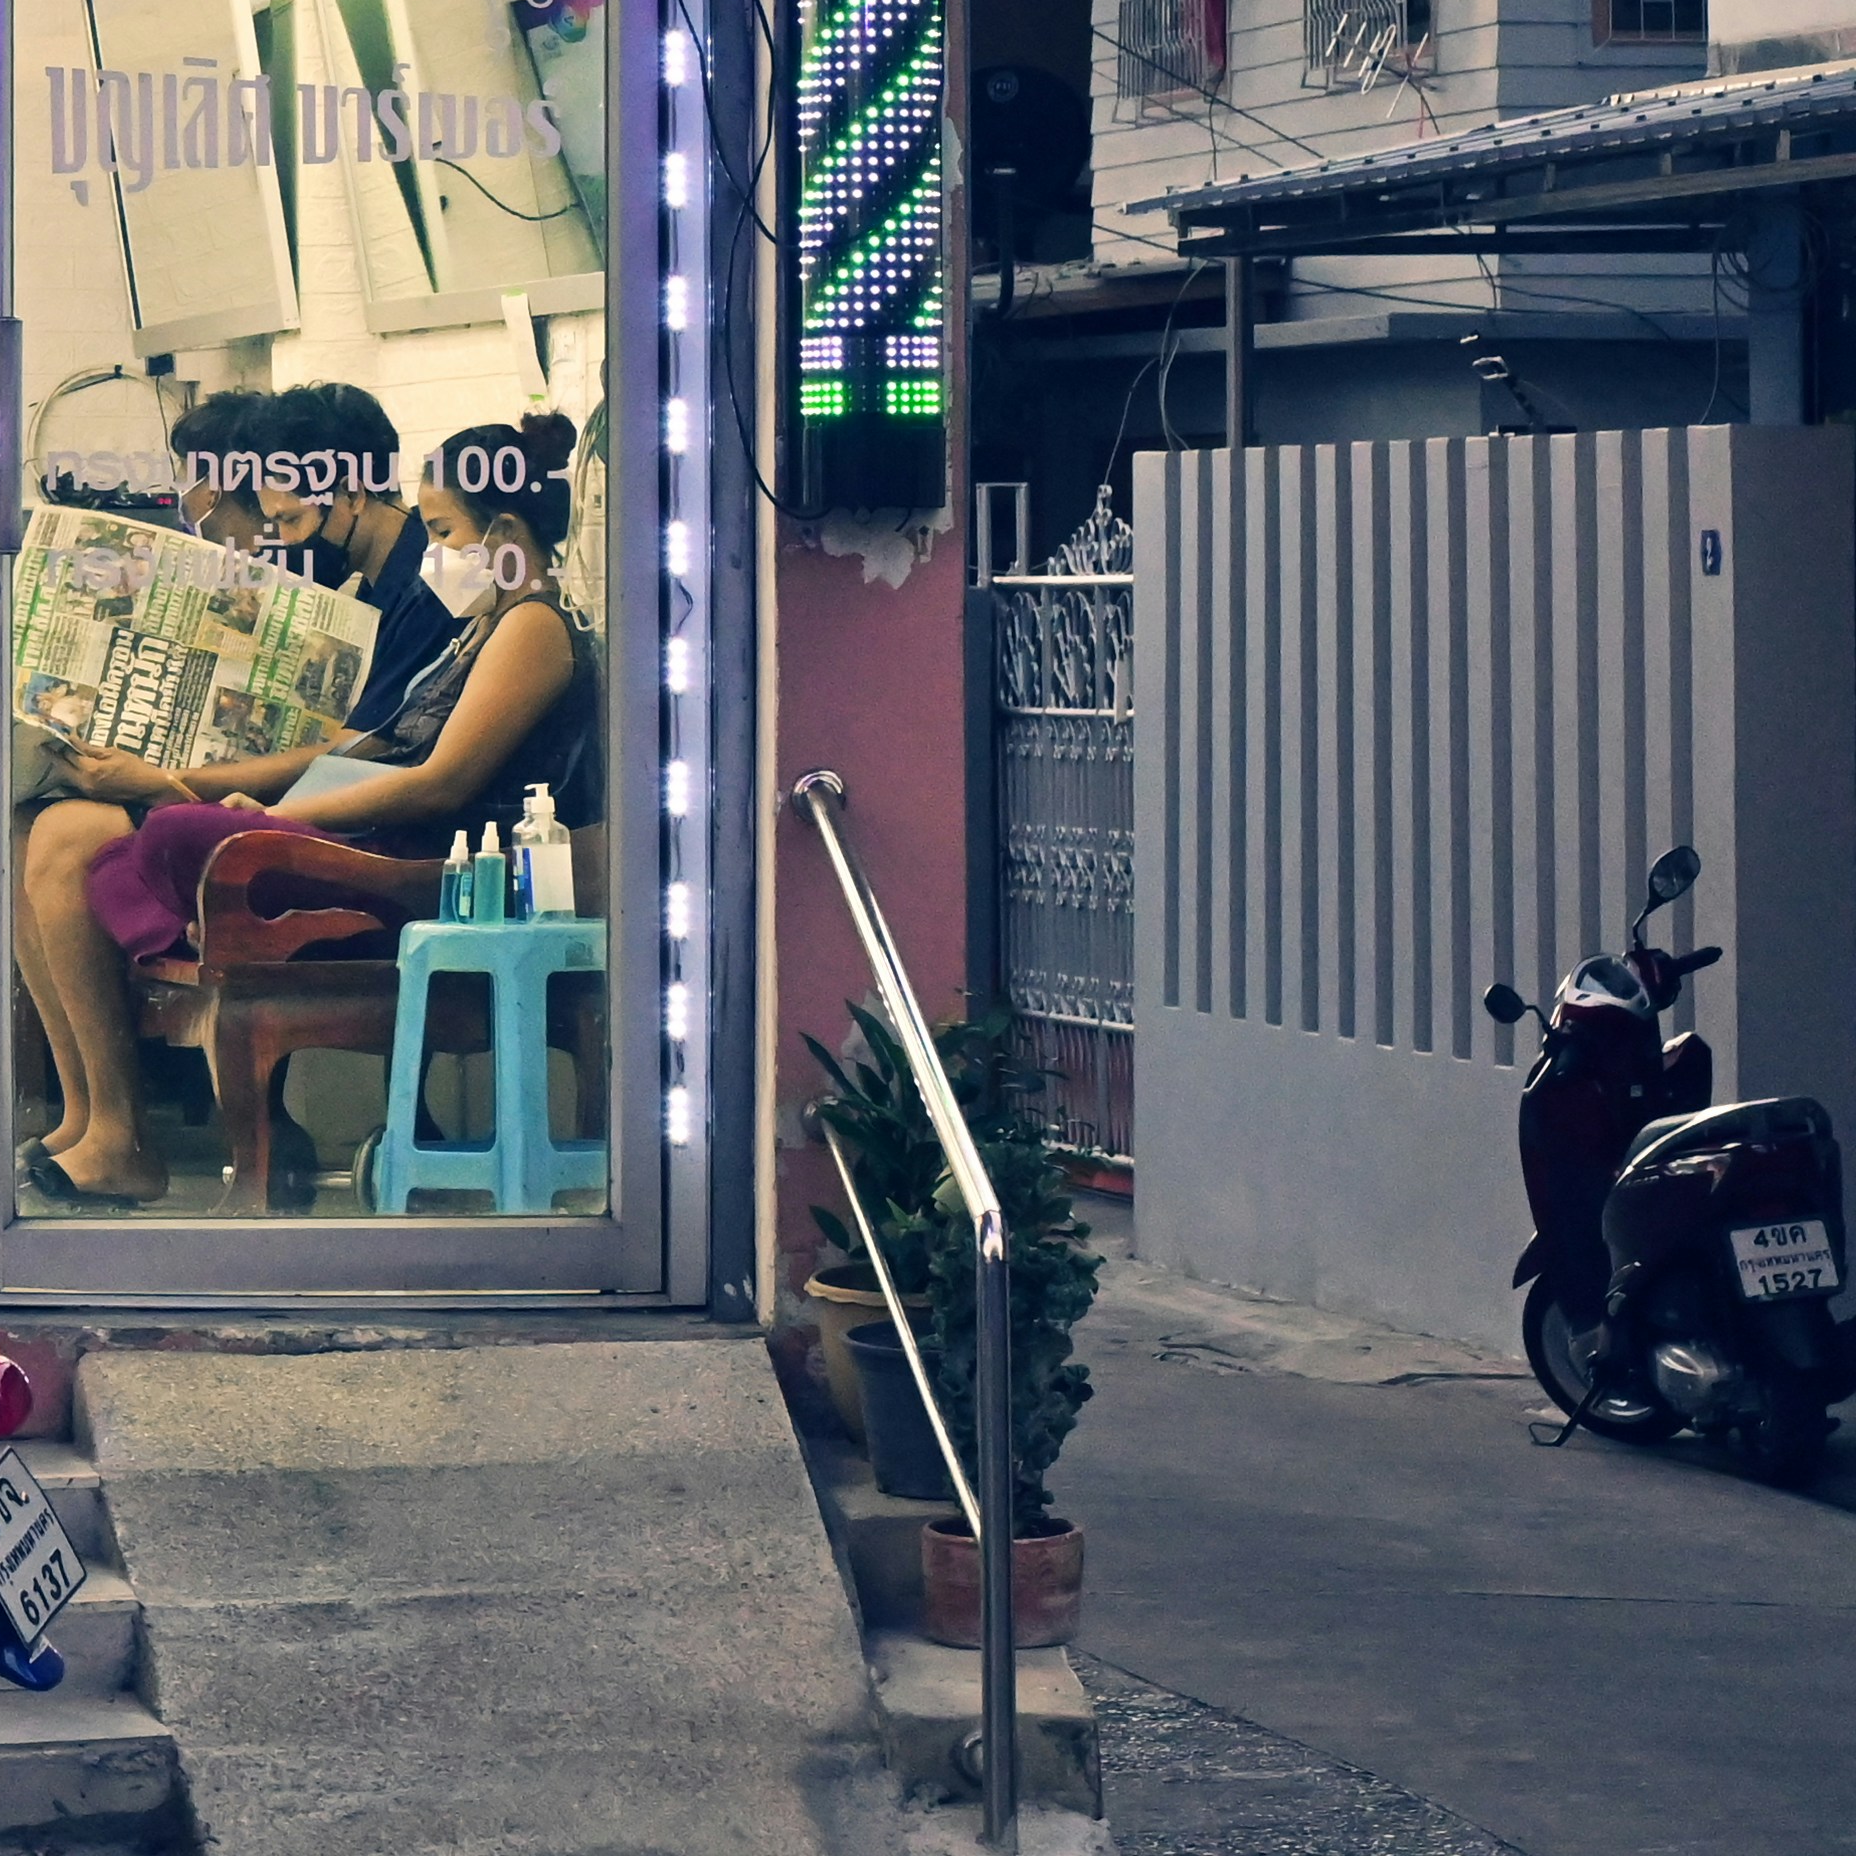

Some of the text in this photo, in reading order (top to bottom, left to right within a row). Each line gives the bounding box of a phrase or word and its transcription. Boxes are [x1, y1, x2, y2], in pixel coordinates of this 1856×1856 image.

[44, 56, 564, 207] บุญเลิศ บาร์เบอร์
[45, 446, 570, 506] ทรงมาตรฐาน 100.-
[45, 522, 315, 592] ทรงแฟชั่น
[422, 544, 568, 593] 120.-
[1758, 1269, 1822, 1295] 1527
[19, 1547, 71, 1626] 6137
